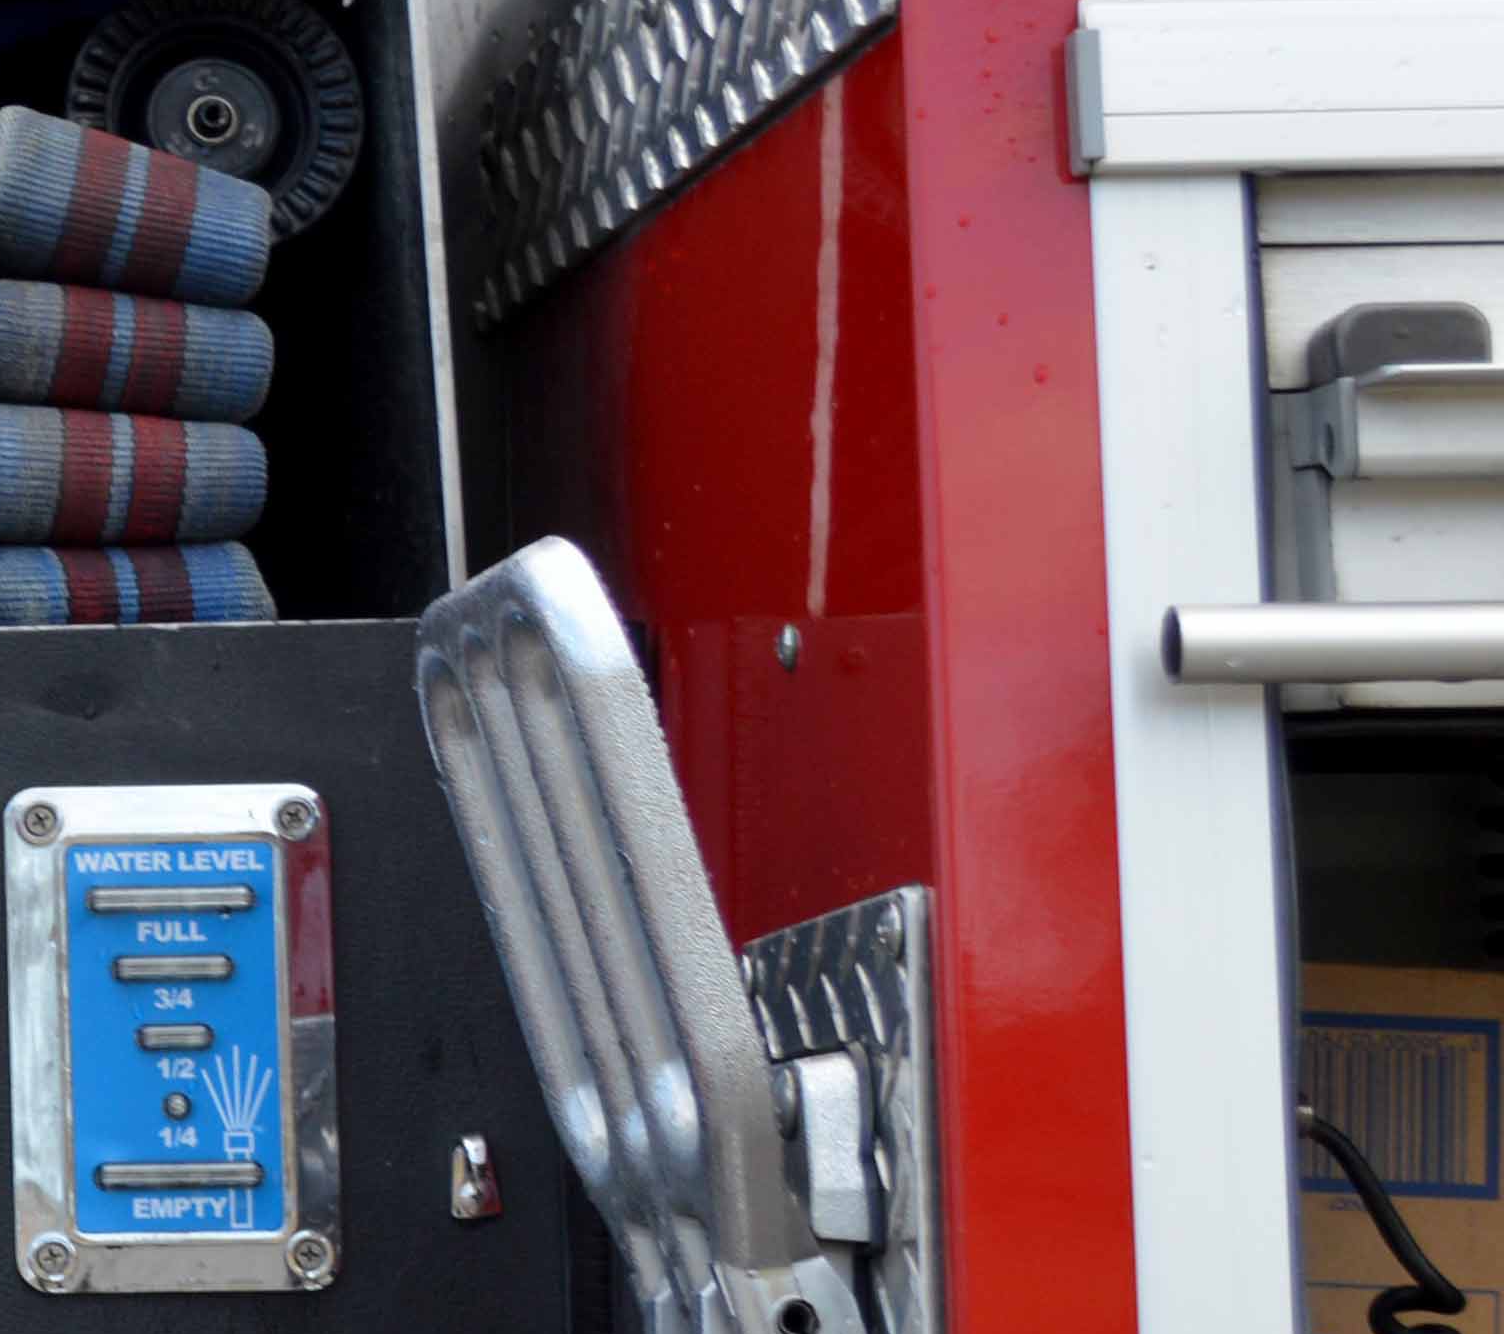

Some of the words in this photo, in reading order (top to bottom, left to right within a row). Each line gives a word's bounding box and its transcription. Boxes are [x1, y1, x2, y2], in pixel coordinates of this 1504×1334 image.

[74, 851, 173, 873] WATER
[178, 850, 264, 871] LEVEL
[137, 922, 207, 943] FULL
[153, 988, 194, 1010] 3/4
[155, 1058, 196, 1079] 1/2
[159, 1127, 198, 1148] 1/4
[133, 1197, 226, 1220] EMPTY
